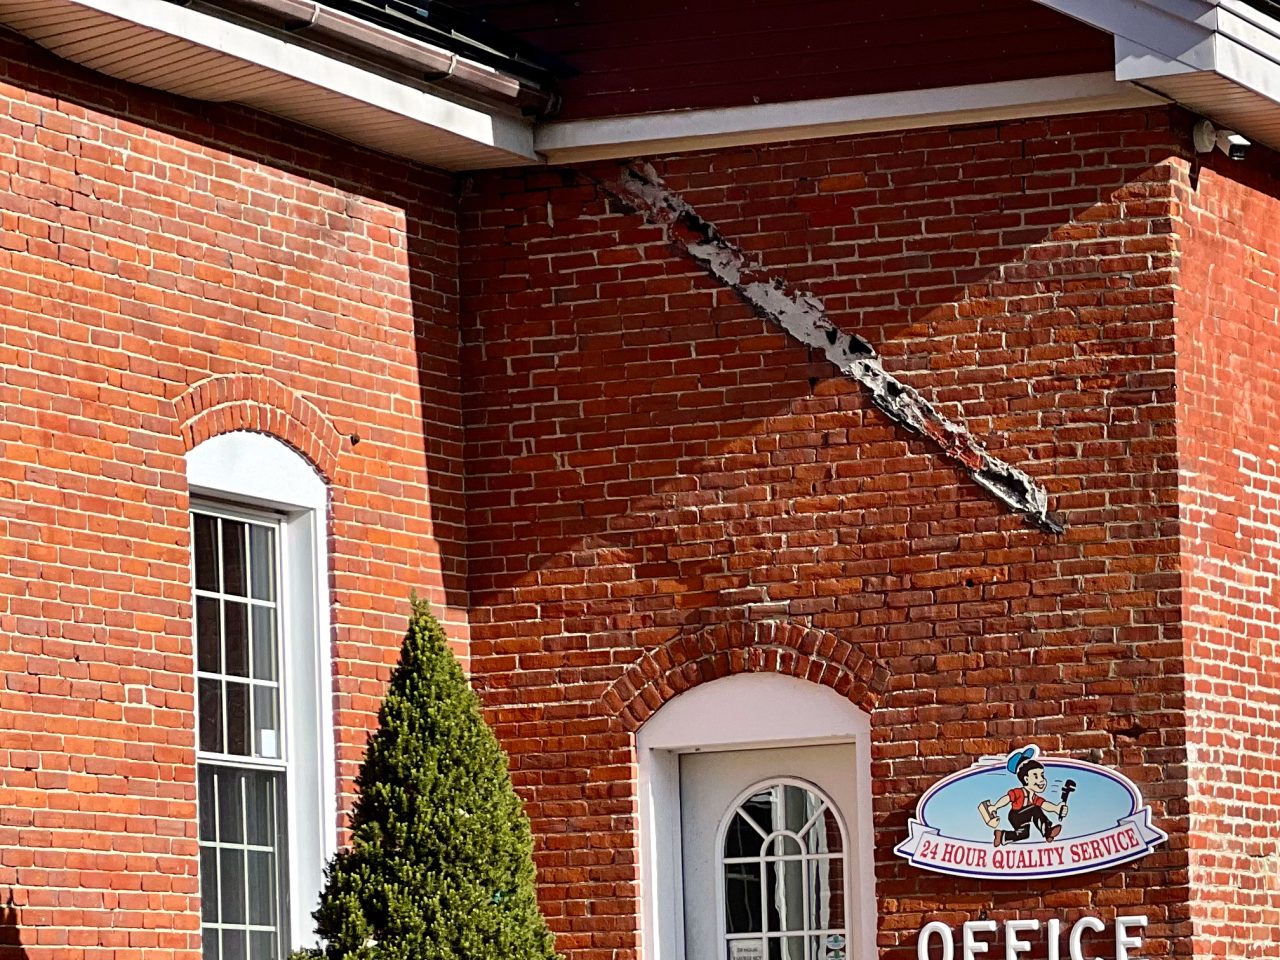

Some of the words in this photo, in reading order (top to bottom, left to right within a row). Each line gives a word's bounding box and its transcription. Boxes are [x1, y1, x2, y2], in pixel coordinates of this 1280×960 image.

[920, 840, 938, 859] 24
[941, 843, 987, 867] HOUR
[992, 847, 1064, 869] QUALITY
[1070, 828, 1139, 863] SERVICE
